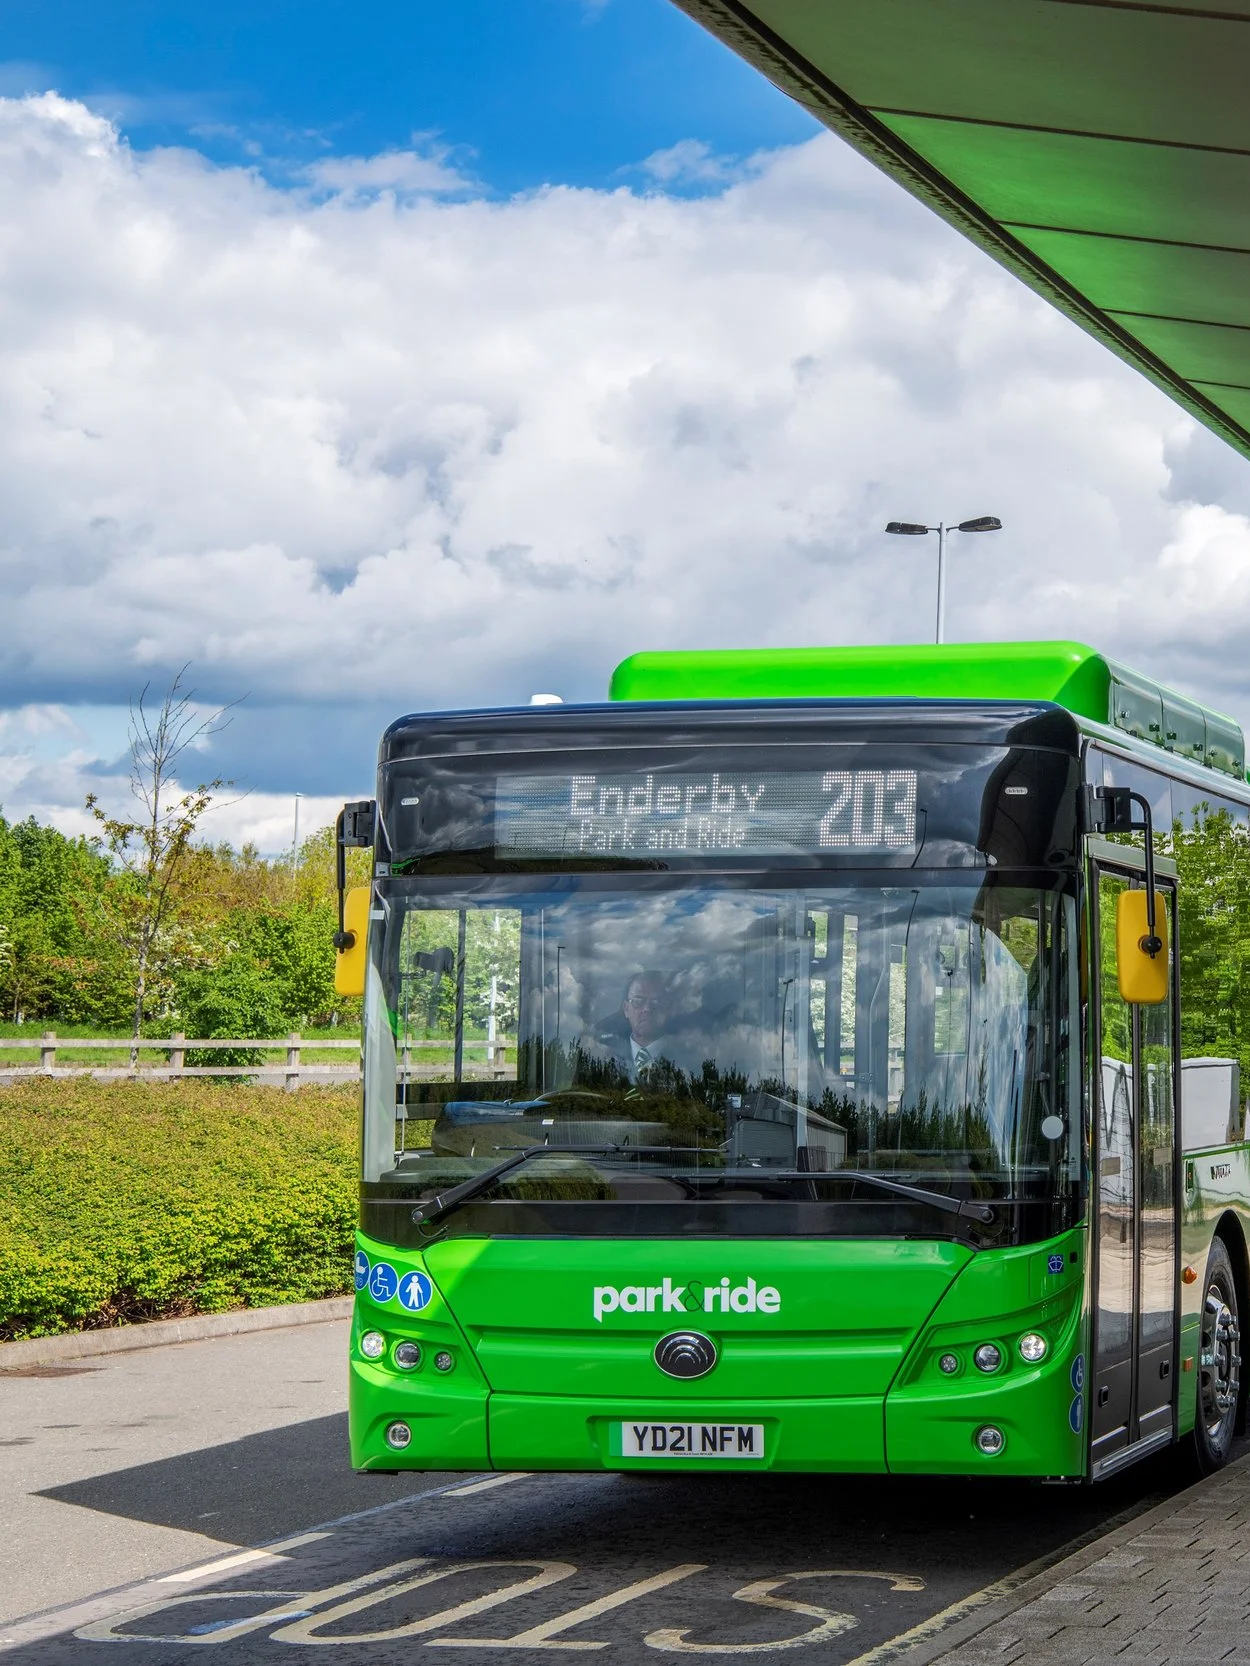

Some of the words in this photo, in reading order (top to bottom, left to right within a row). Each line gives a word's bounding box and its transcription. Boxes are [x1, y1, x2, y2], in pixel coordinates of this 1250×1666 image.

[570, 773, 765, 815] Enderby
[819, 769, 918, 847] 203
[579, 818, 637, 851] Park
[647, 817, 688, 850] and
[698, 816, 746, 849] Ride
[633, 1425, 693, 1451] YD21
[701, 1426, 754, 1452] NFM
[72, 1557, 926, 1654] STOP
